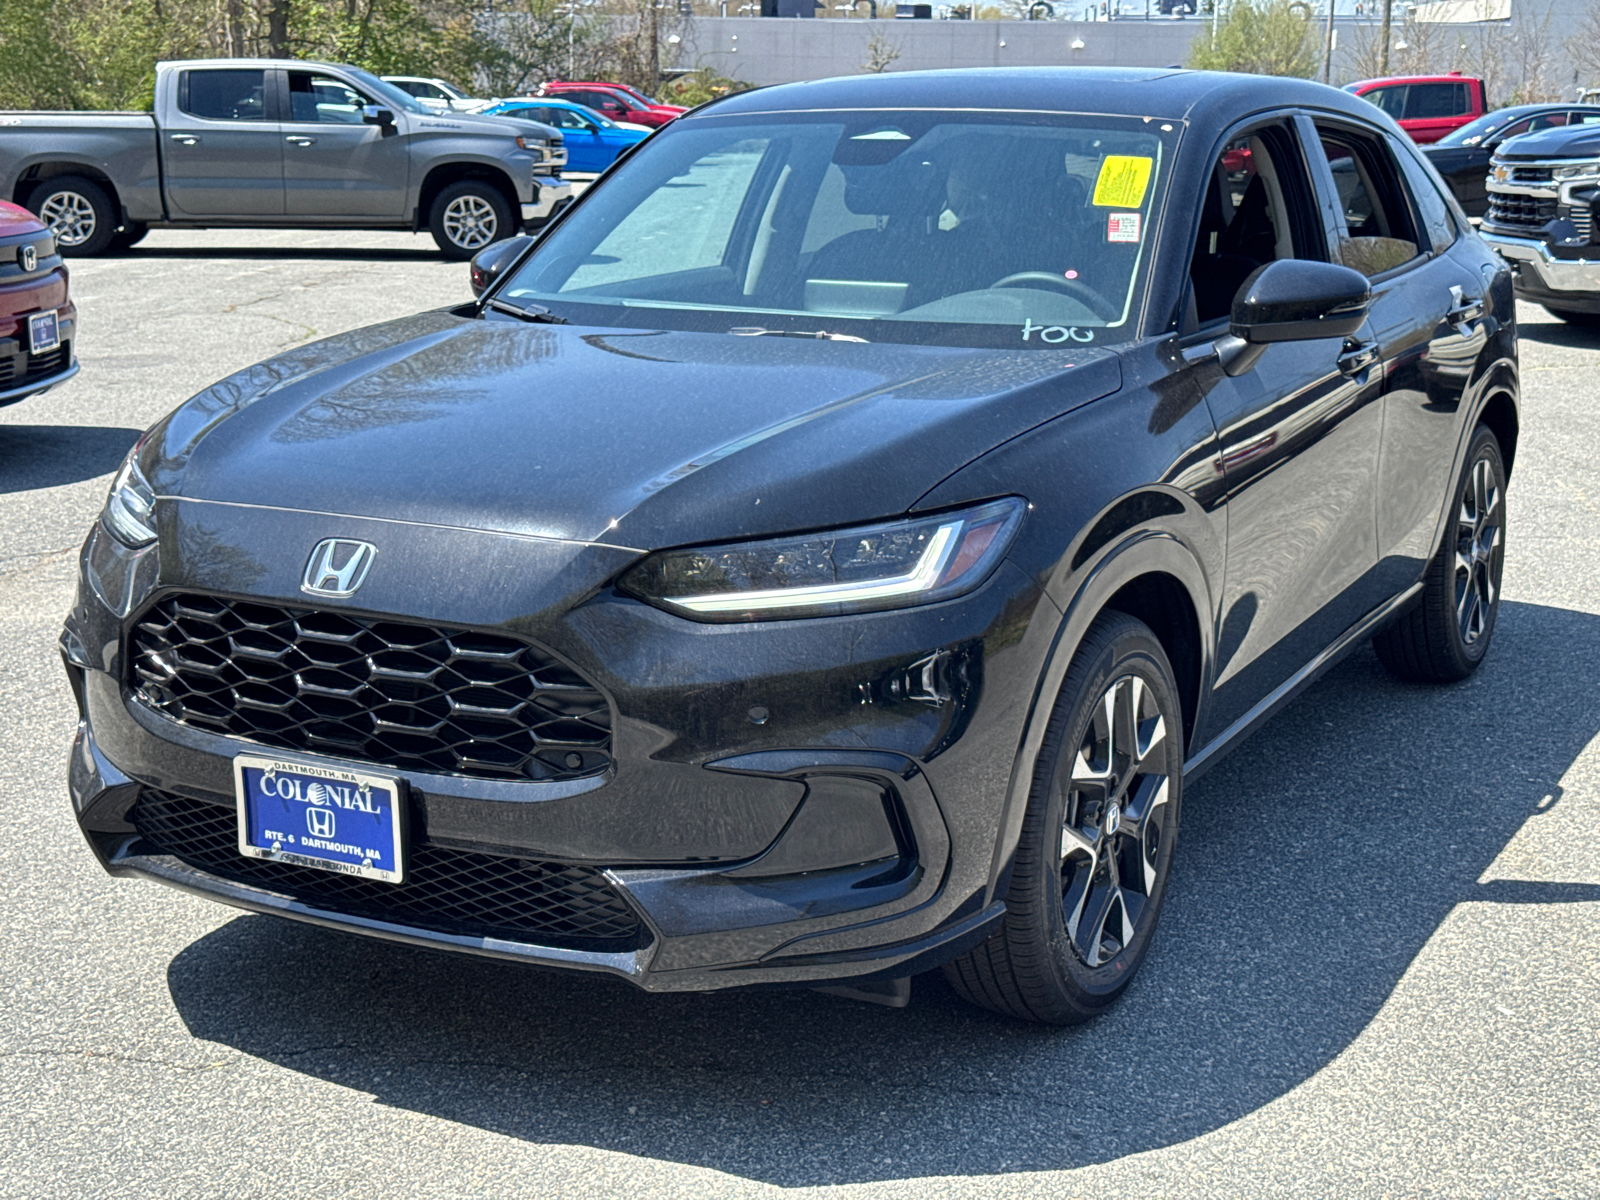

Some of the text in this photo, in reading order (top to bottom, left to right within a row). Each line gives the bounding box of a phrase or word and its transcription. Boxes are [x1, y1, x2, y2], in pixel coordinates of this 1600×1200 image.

[341, 773, 357, 782] MA
[260, 775, 380, 814] COLONIAL
[264, 829, 381, 860] RTE. 6 DARTMOUTH, MA
